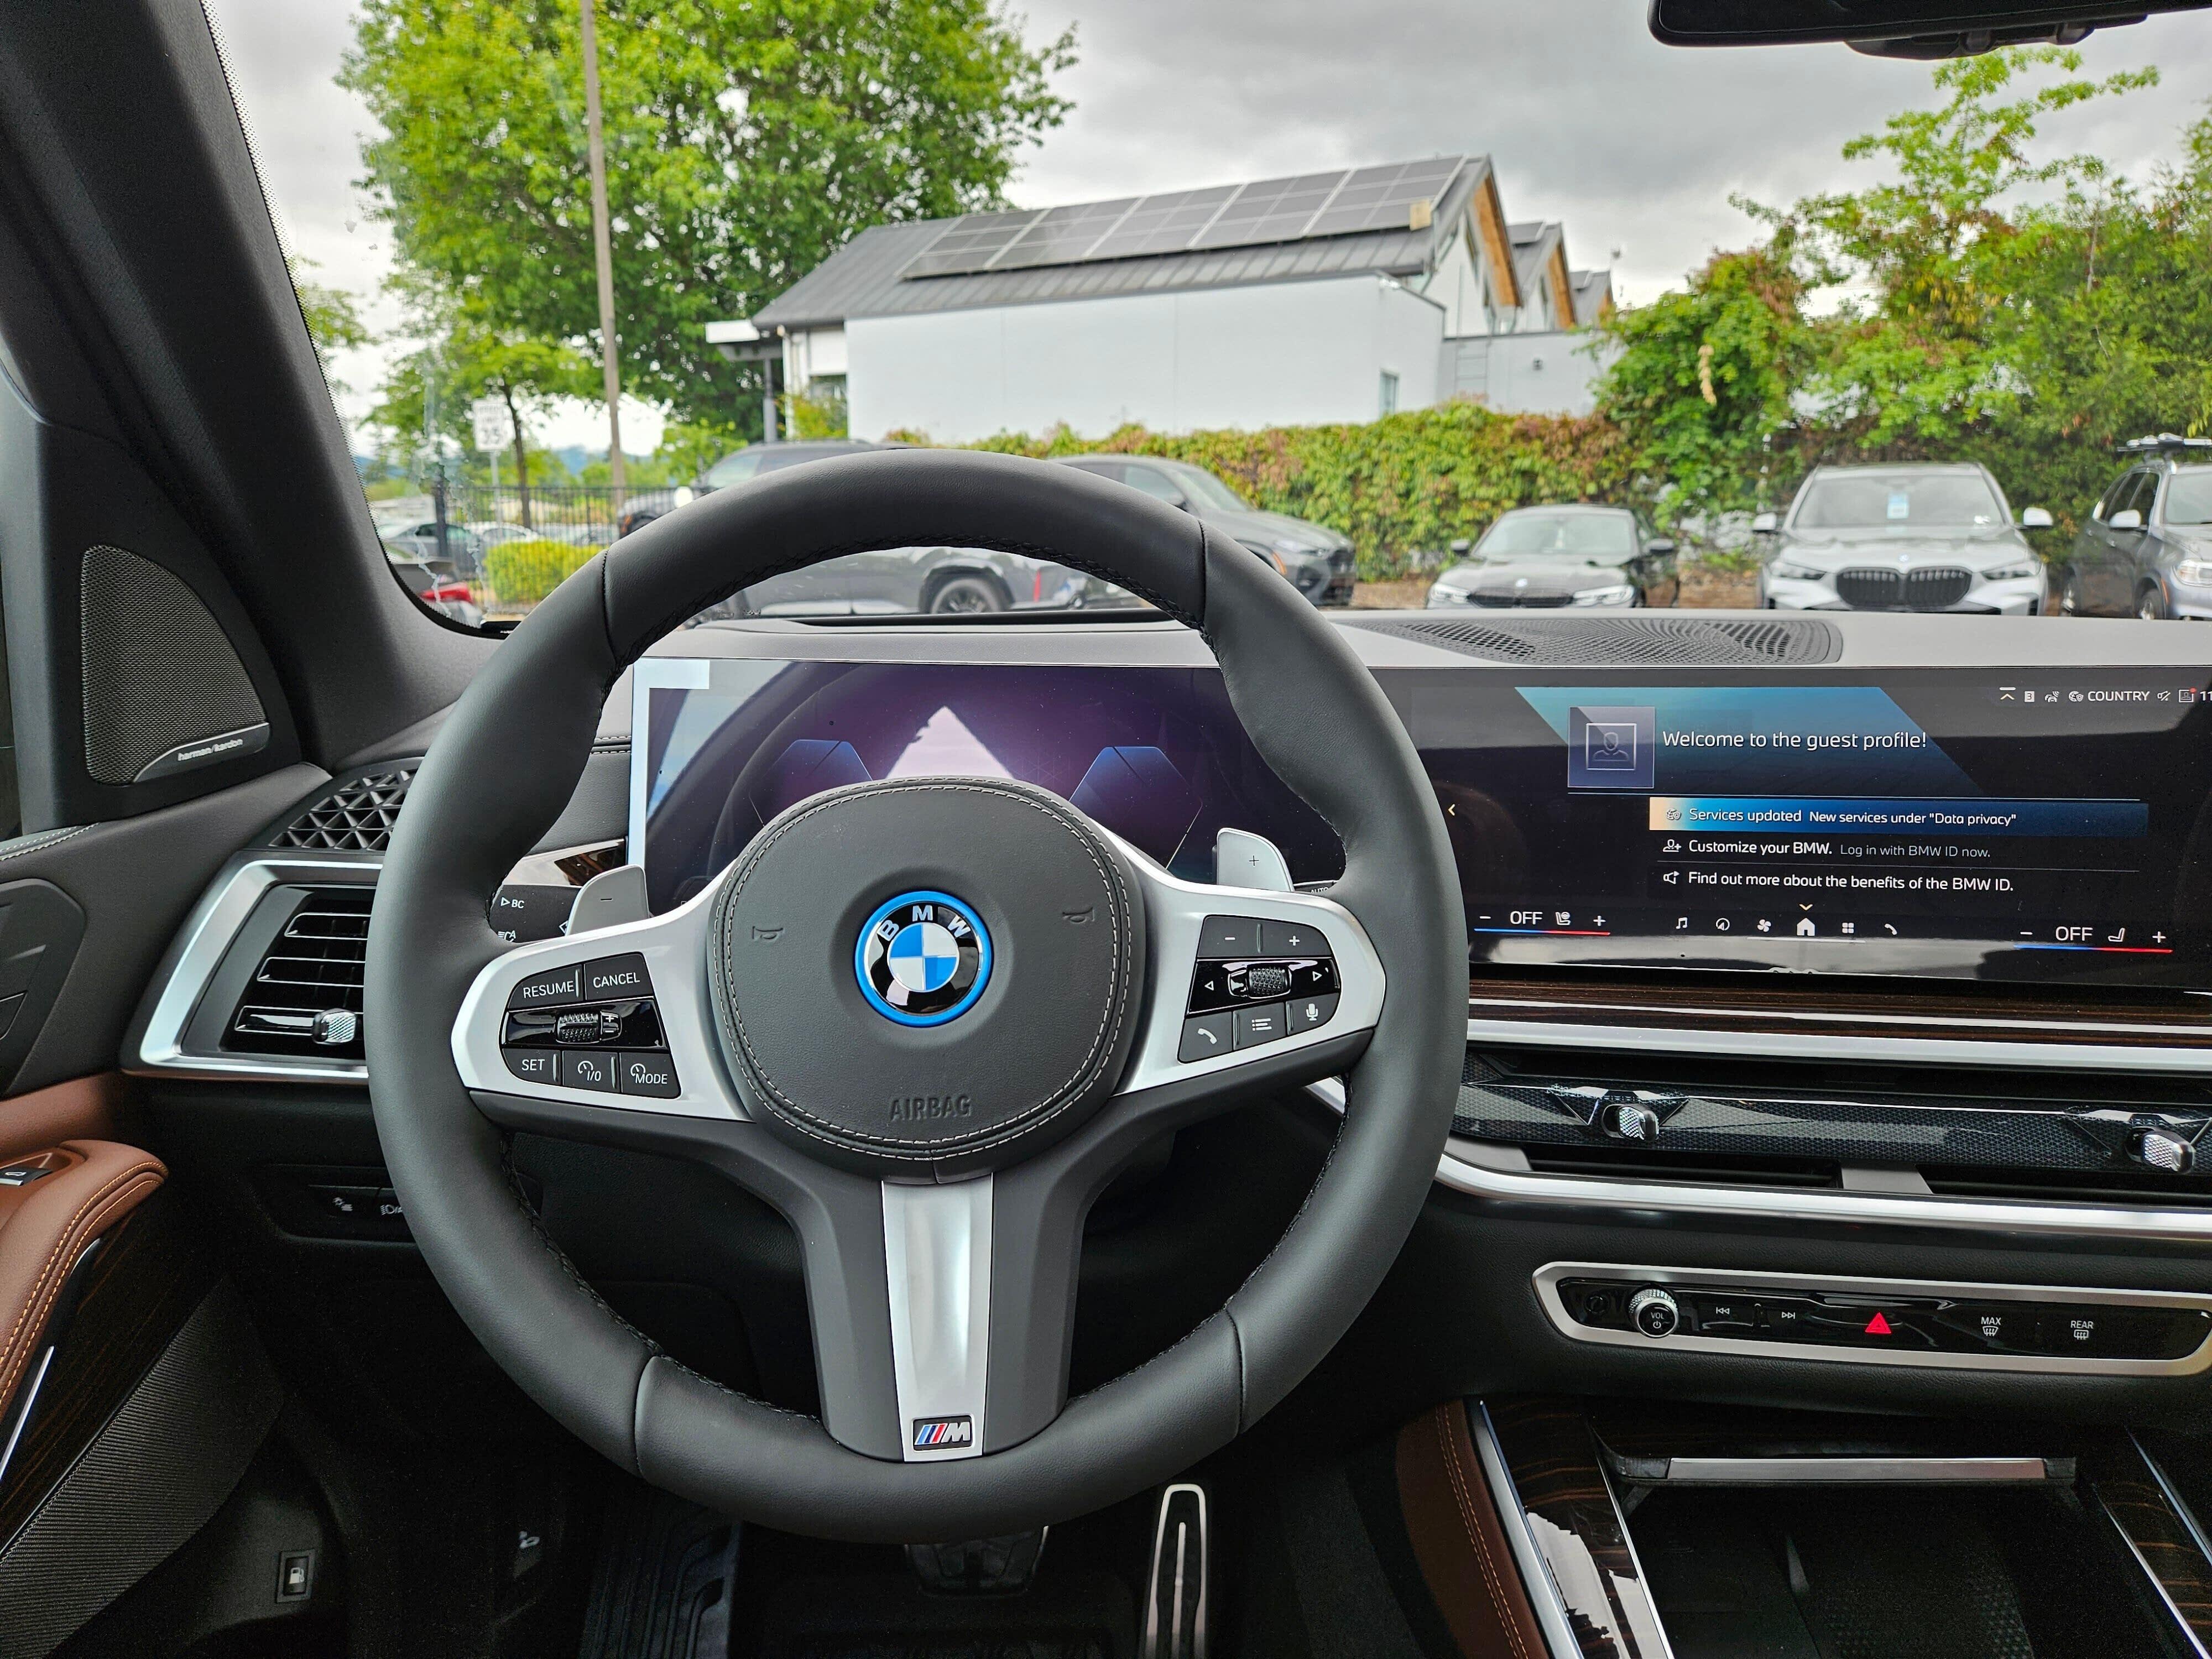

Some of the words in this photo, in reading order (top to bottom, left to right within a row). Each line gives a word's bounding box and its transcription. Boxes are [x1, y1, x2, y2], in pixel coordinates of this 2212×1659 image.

[2088, 691, 2150, 701] COUNTRY
[1662, 731, 1744, 748] Welcome
[1750, 733, 1766, 748] to
[1773, 732, 1801, 748] the
[1807, 733, 1858, 751] guest
[1864, 732, 1927, 750] profile!
[1689, 808, 1744, 821] Services
[1747, 810, 1802, 823] updated
[1809, 811, 1837, 822] New
[1839, 812, 1887, 823] services
[1891, 812, 1927, 823] under
[1929, 813, 1964, 825] "Data
[1968, 813, 2016, 827] privacy"
[1689, 840, 1757, 853] Customize
[1760, 844, 1790, 855] your
[1793, 842, 1833, 854] BMW.
[1840, 844, 1862, 857] Log
[1866, 845, 1876, 855] in
[1880, 845, 1905, 856] with
[1908, 846, 1942, 857] BMW
[1945, 846, 1958, 857] ID
[1962, 848, 1990, 857] now.
[1689, 872, 1717, 884] Find
[1721, 874, 1743, 885] out
[1746, 876, 1780, 886] more
[1783, 874, 1823, 887] about
[1825, 876, 1847, 888] the
[1851, 876, 1905, 889] benefits
[1908, 877, 1923, 889] of
[1926, 878, 1948, 890] the
[1953, 878, 1991, 891] BMW
[1995, 879, 2014, 891] ID.
[512, 899, 524, 909] BC
[877, 905, 971, 941] BMW
[1510, 911, 1543, 925] OFF
[2056, 926, 2093, 941] OFF
[593, 972, 640, 988] CANCEL
[523, 980, 575, 999] RESUME
[521, 1059, 545, 1071] SET
[635, 1073, 667, 1084] MODE
[890, 1094, 972, 1121] AIRBAG
[1981, 1316, 2001, 1326] MAX
[2070, 1320, 2094, 1329] REAR
